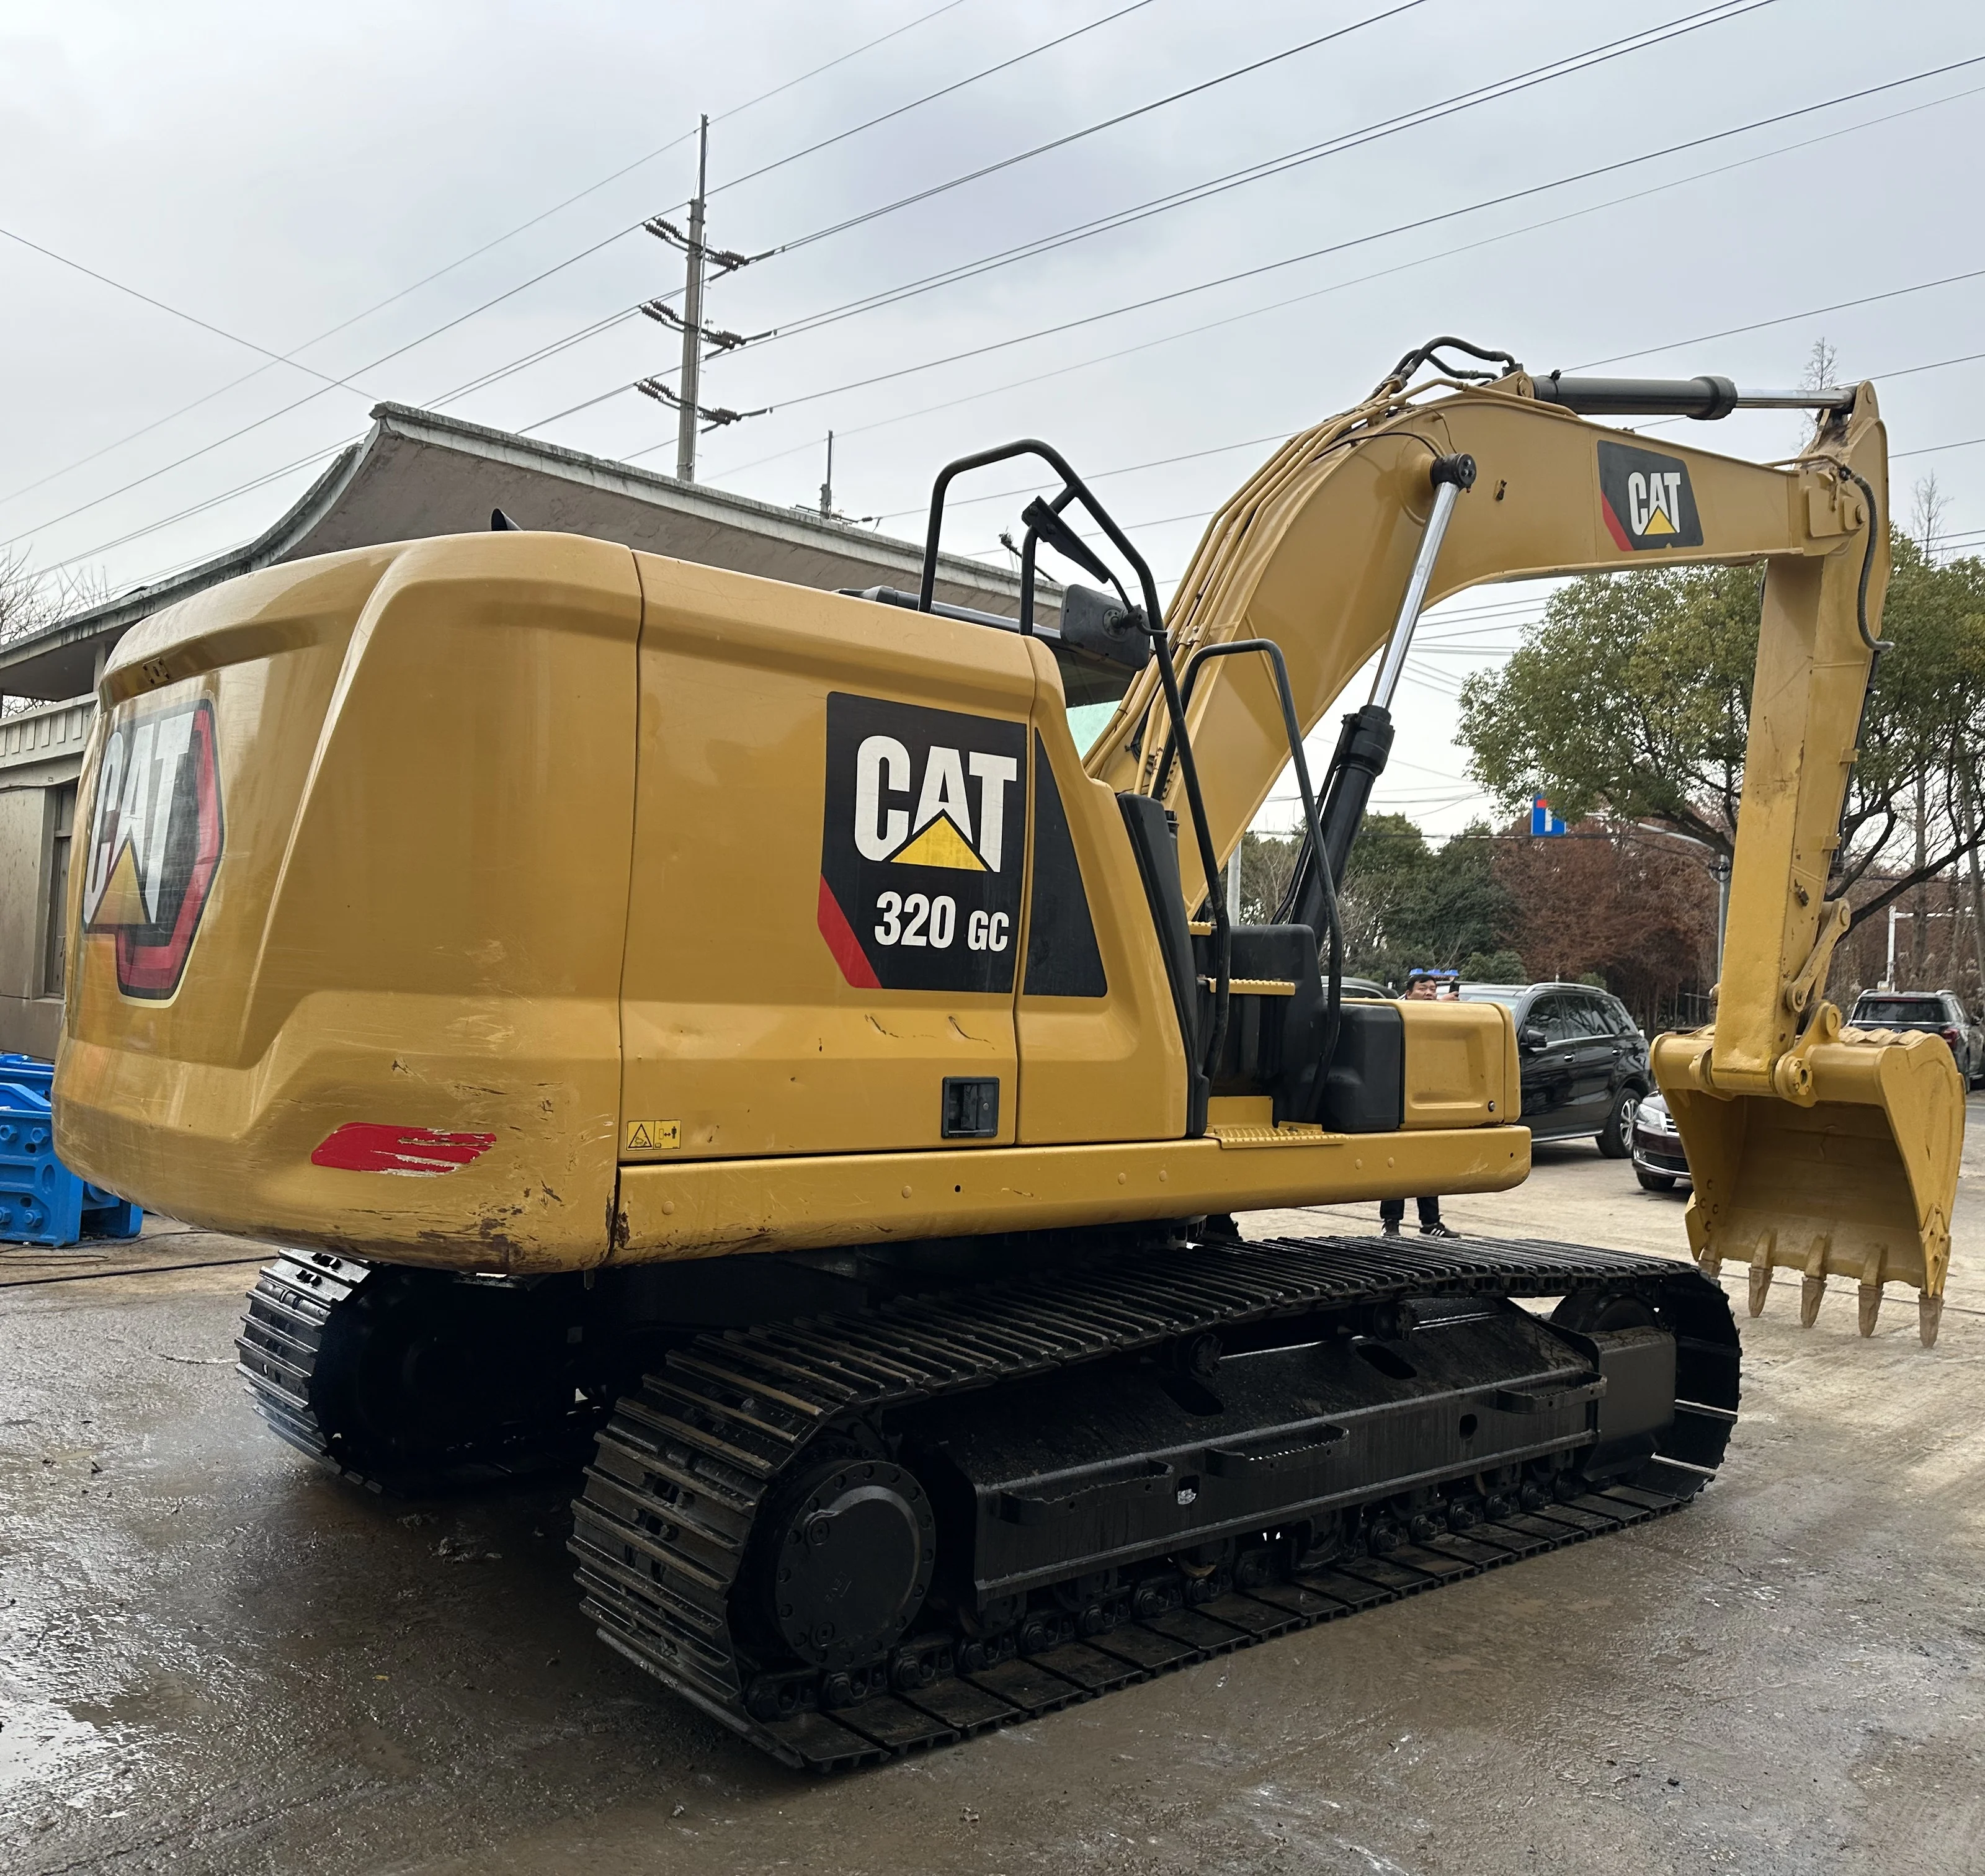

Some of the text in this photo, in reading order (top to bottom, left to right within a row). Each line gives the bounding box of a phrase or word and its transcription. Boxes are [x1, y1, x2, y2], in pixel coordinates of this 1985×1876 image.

[1628, 471, 1681, 535] CAT
[83, 711, 195, 924] CAT
[854, 735, 1017, 873] CAT
[875, 891, 1009, 952] 320 GC
